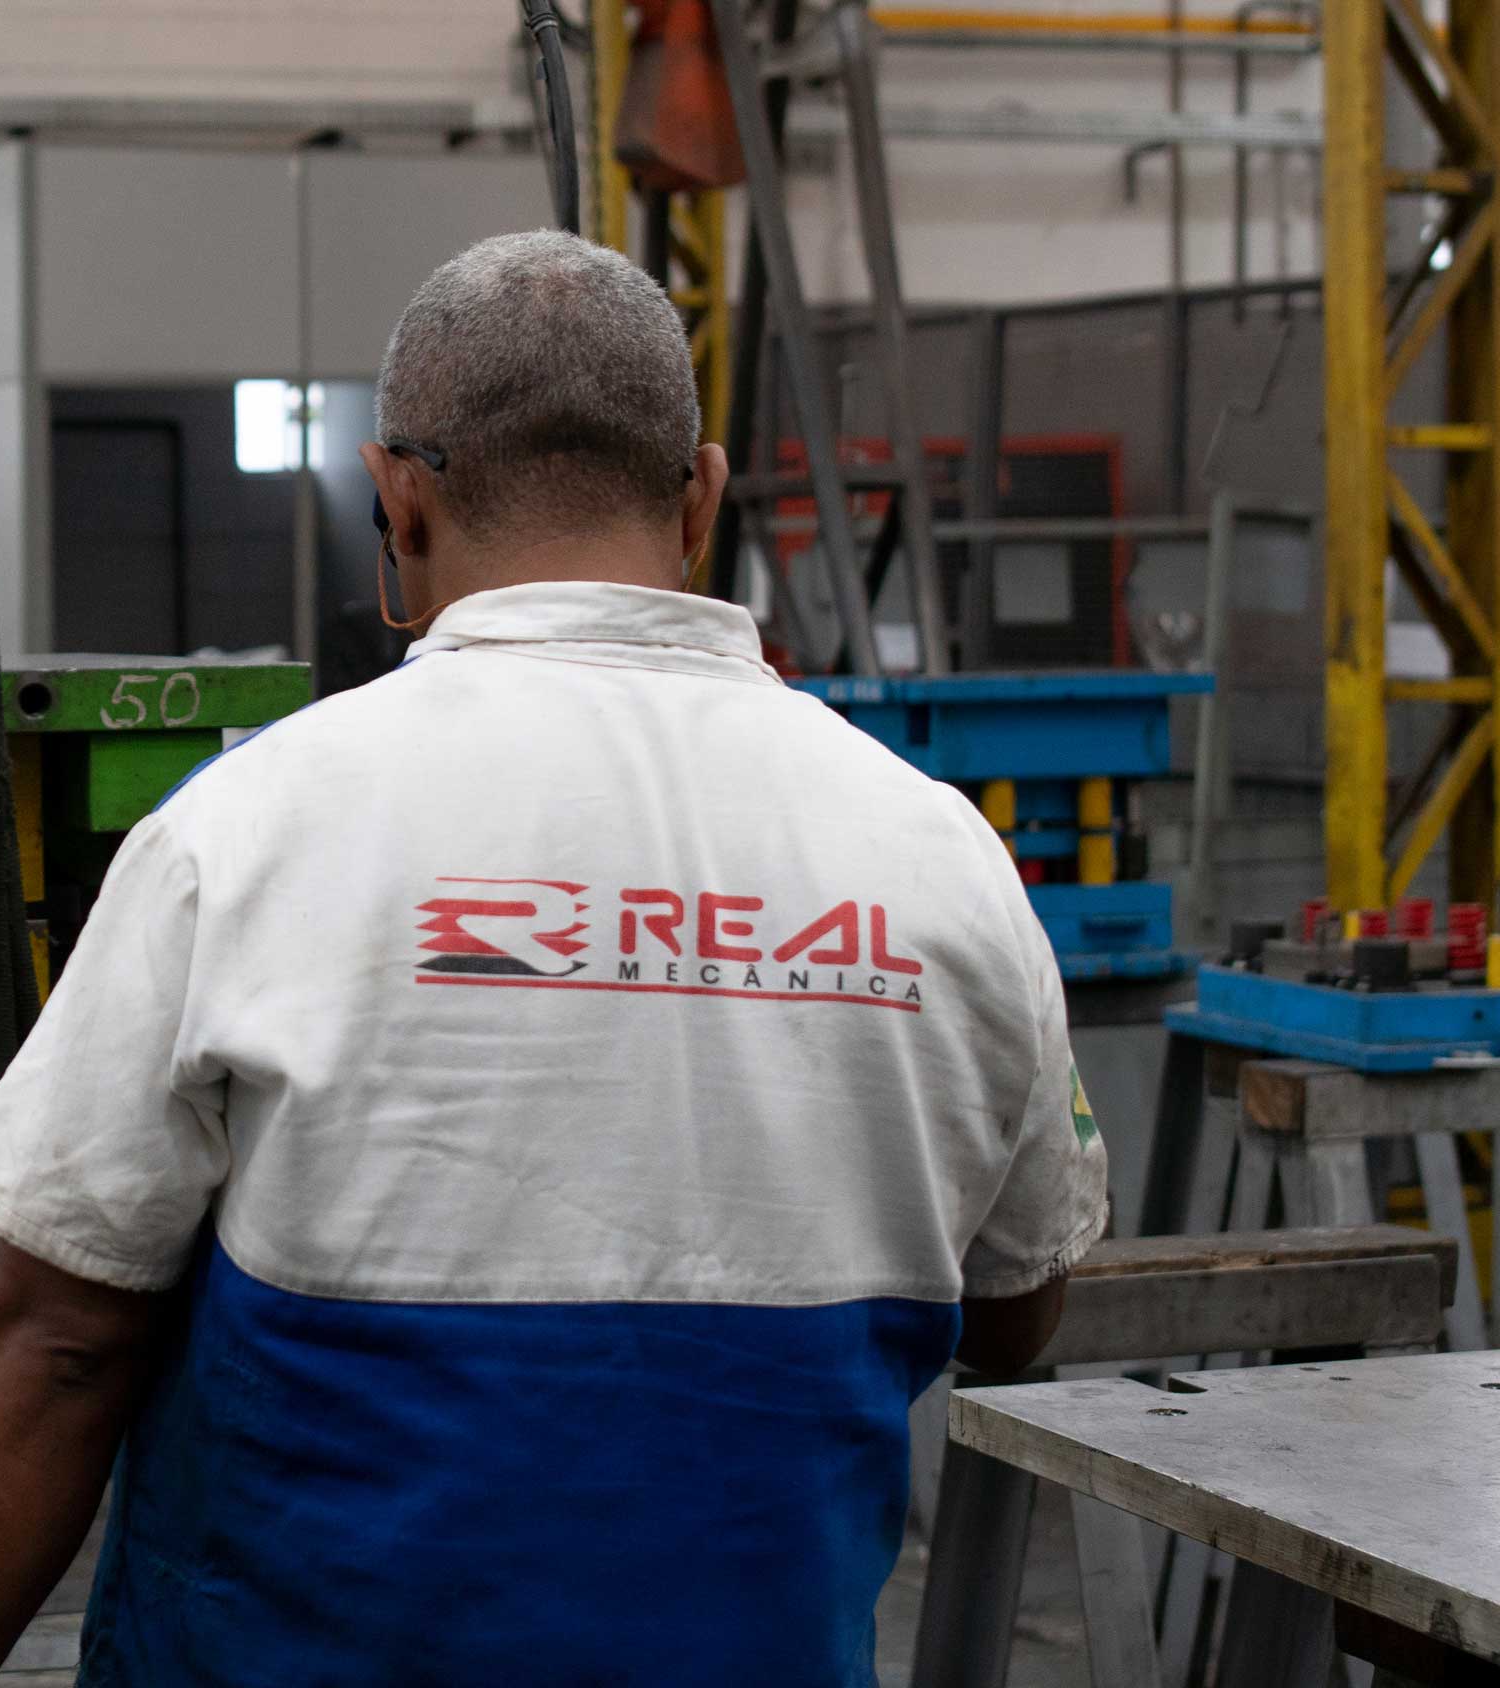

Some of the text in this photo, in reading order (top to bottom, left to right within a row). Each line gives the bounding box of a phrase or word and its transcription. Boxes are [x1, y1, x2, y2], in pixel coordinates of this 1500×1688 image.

[100, 671, 200, 729] 50
[618, 887, 924, 976] REAL
[618, 960, 924, 1002] MECÂNICA
